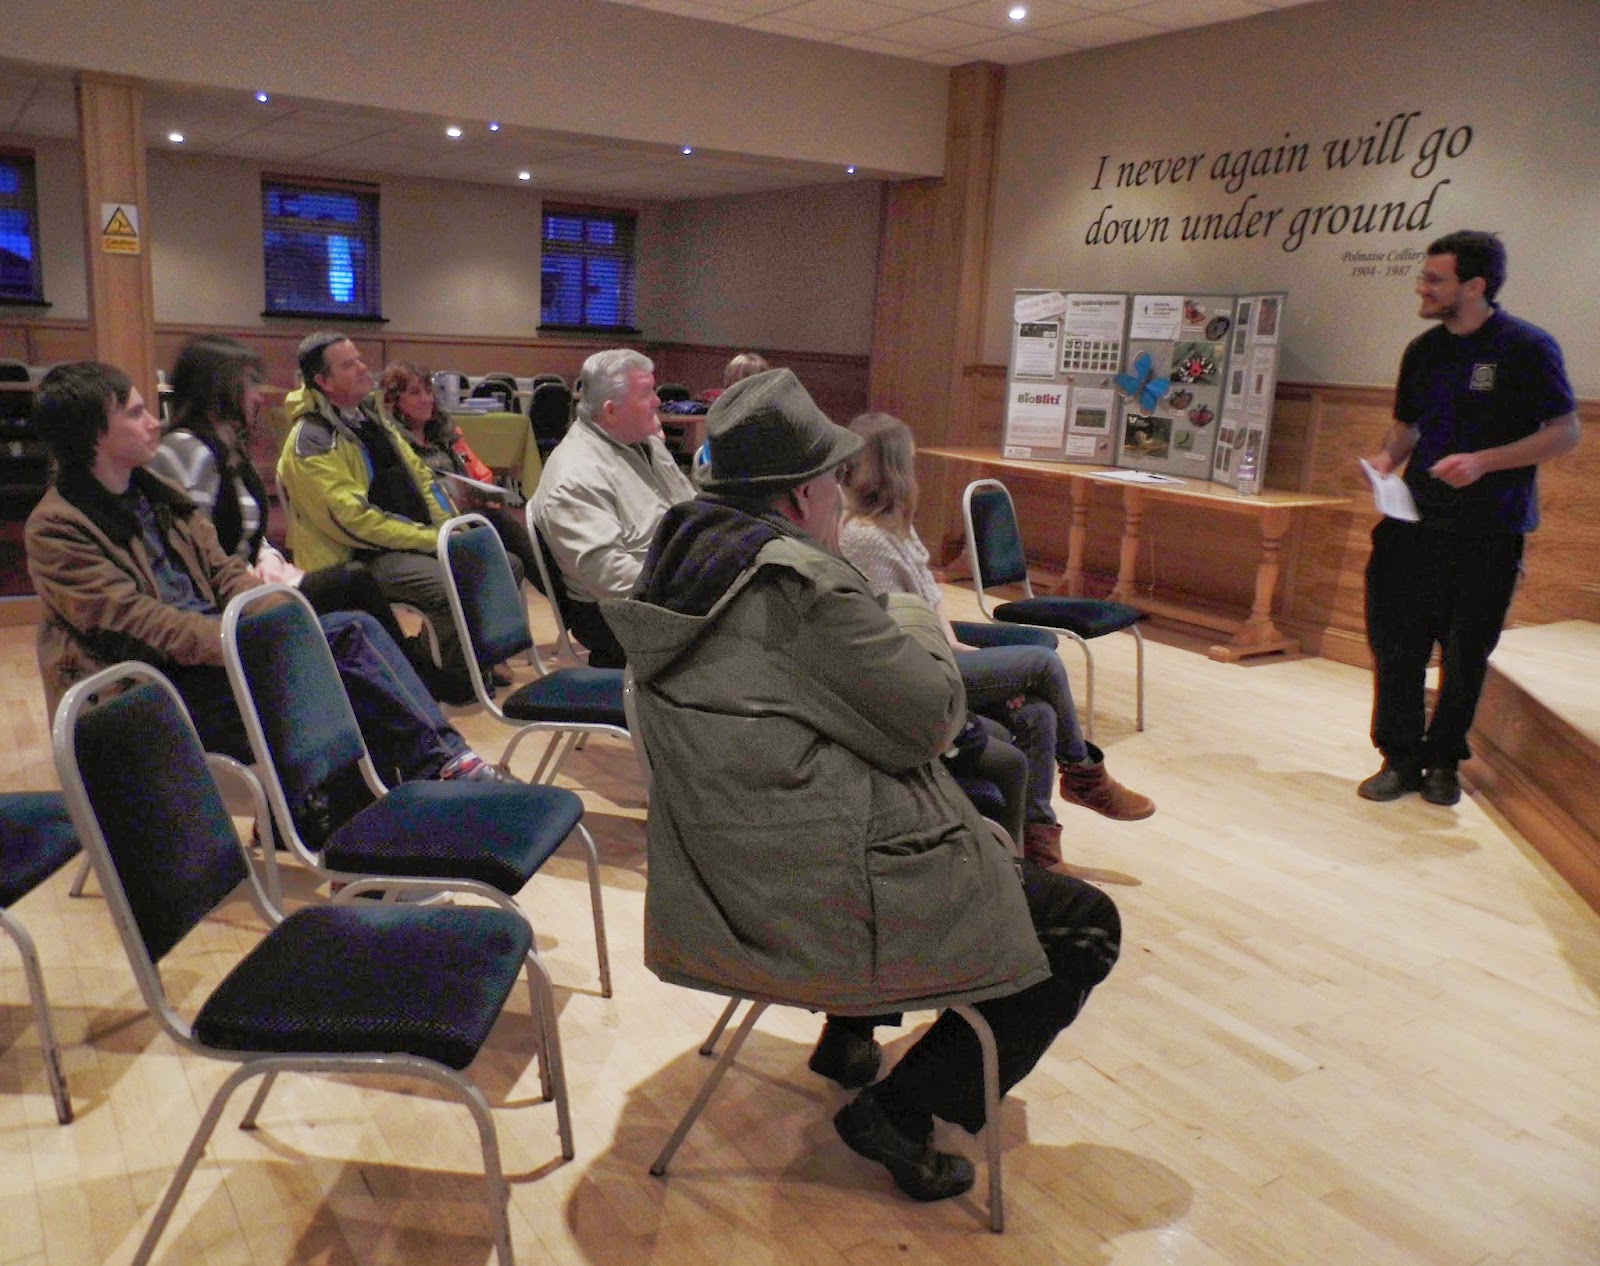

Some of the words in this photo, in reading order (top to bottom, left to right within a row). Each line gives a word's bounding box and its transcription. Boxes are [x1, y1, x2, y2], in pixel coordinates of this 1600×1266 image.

[1091, 155, 1110, 190] I
[1116, 153, 1205, 187] never
[1210, 132, 1309, 194] again
[1323, 111, 1421, 171] will
[1411, 124, 1473, 179] go
[1085, 205, 1169, 246] down
[1181, 194, 1284, 242] under
[1282, 179, 1451, 252] ground
[1018, 392, 1062, 405] BioBlitz
